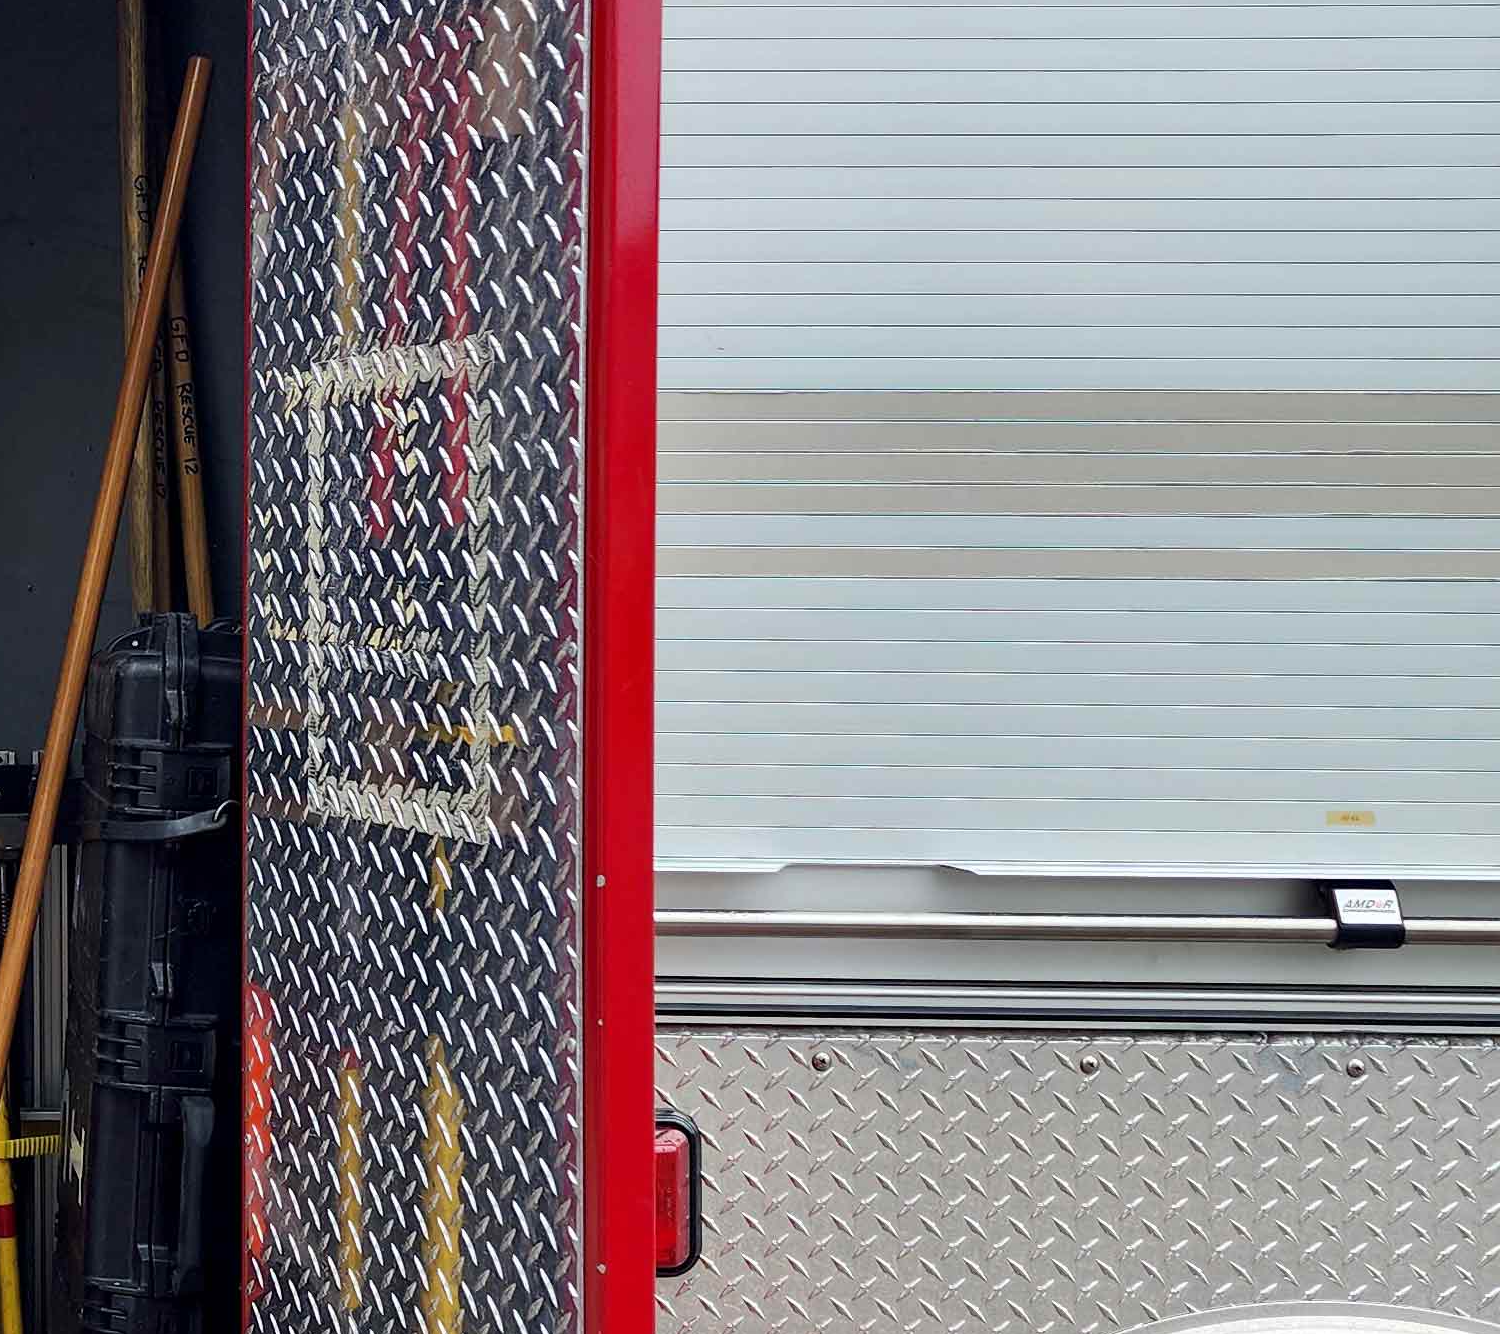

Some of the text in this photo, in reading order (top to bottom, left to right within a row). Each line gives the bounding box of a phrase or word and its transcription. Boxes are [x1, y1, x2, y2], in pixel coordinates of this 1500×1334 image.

[170, 316, 199, 476] GFD RESCUE 12
